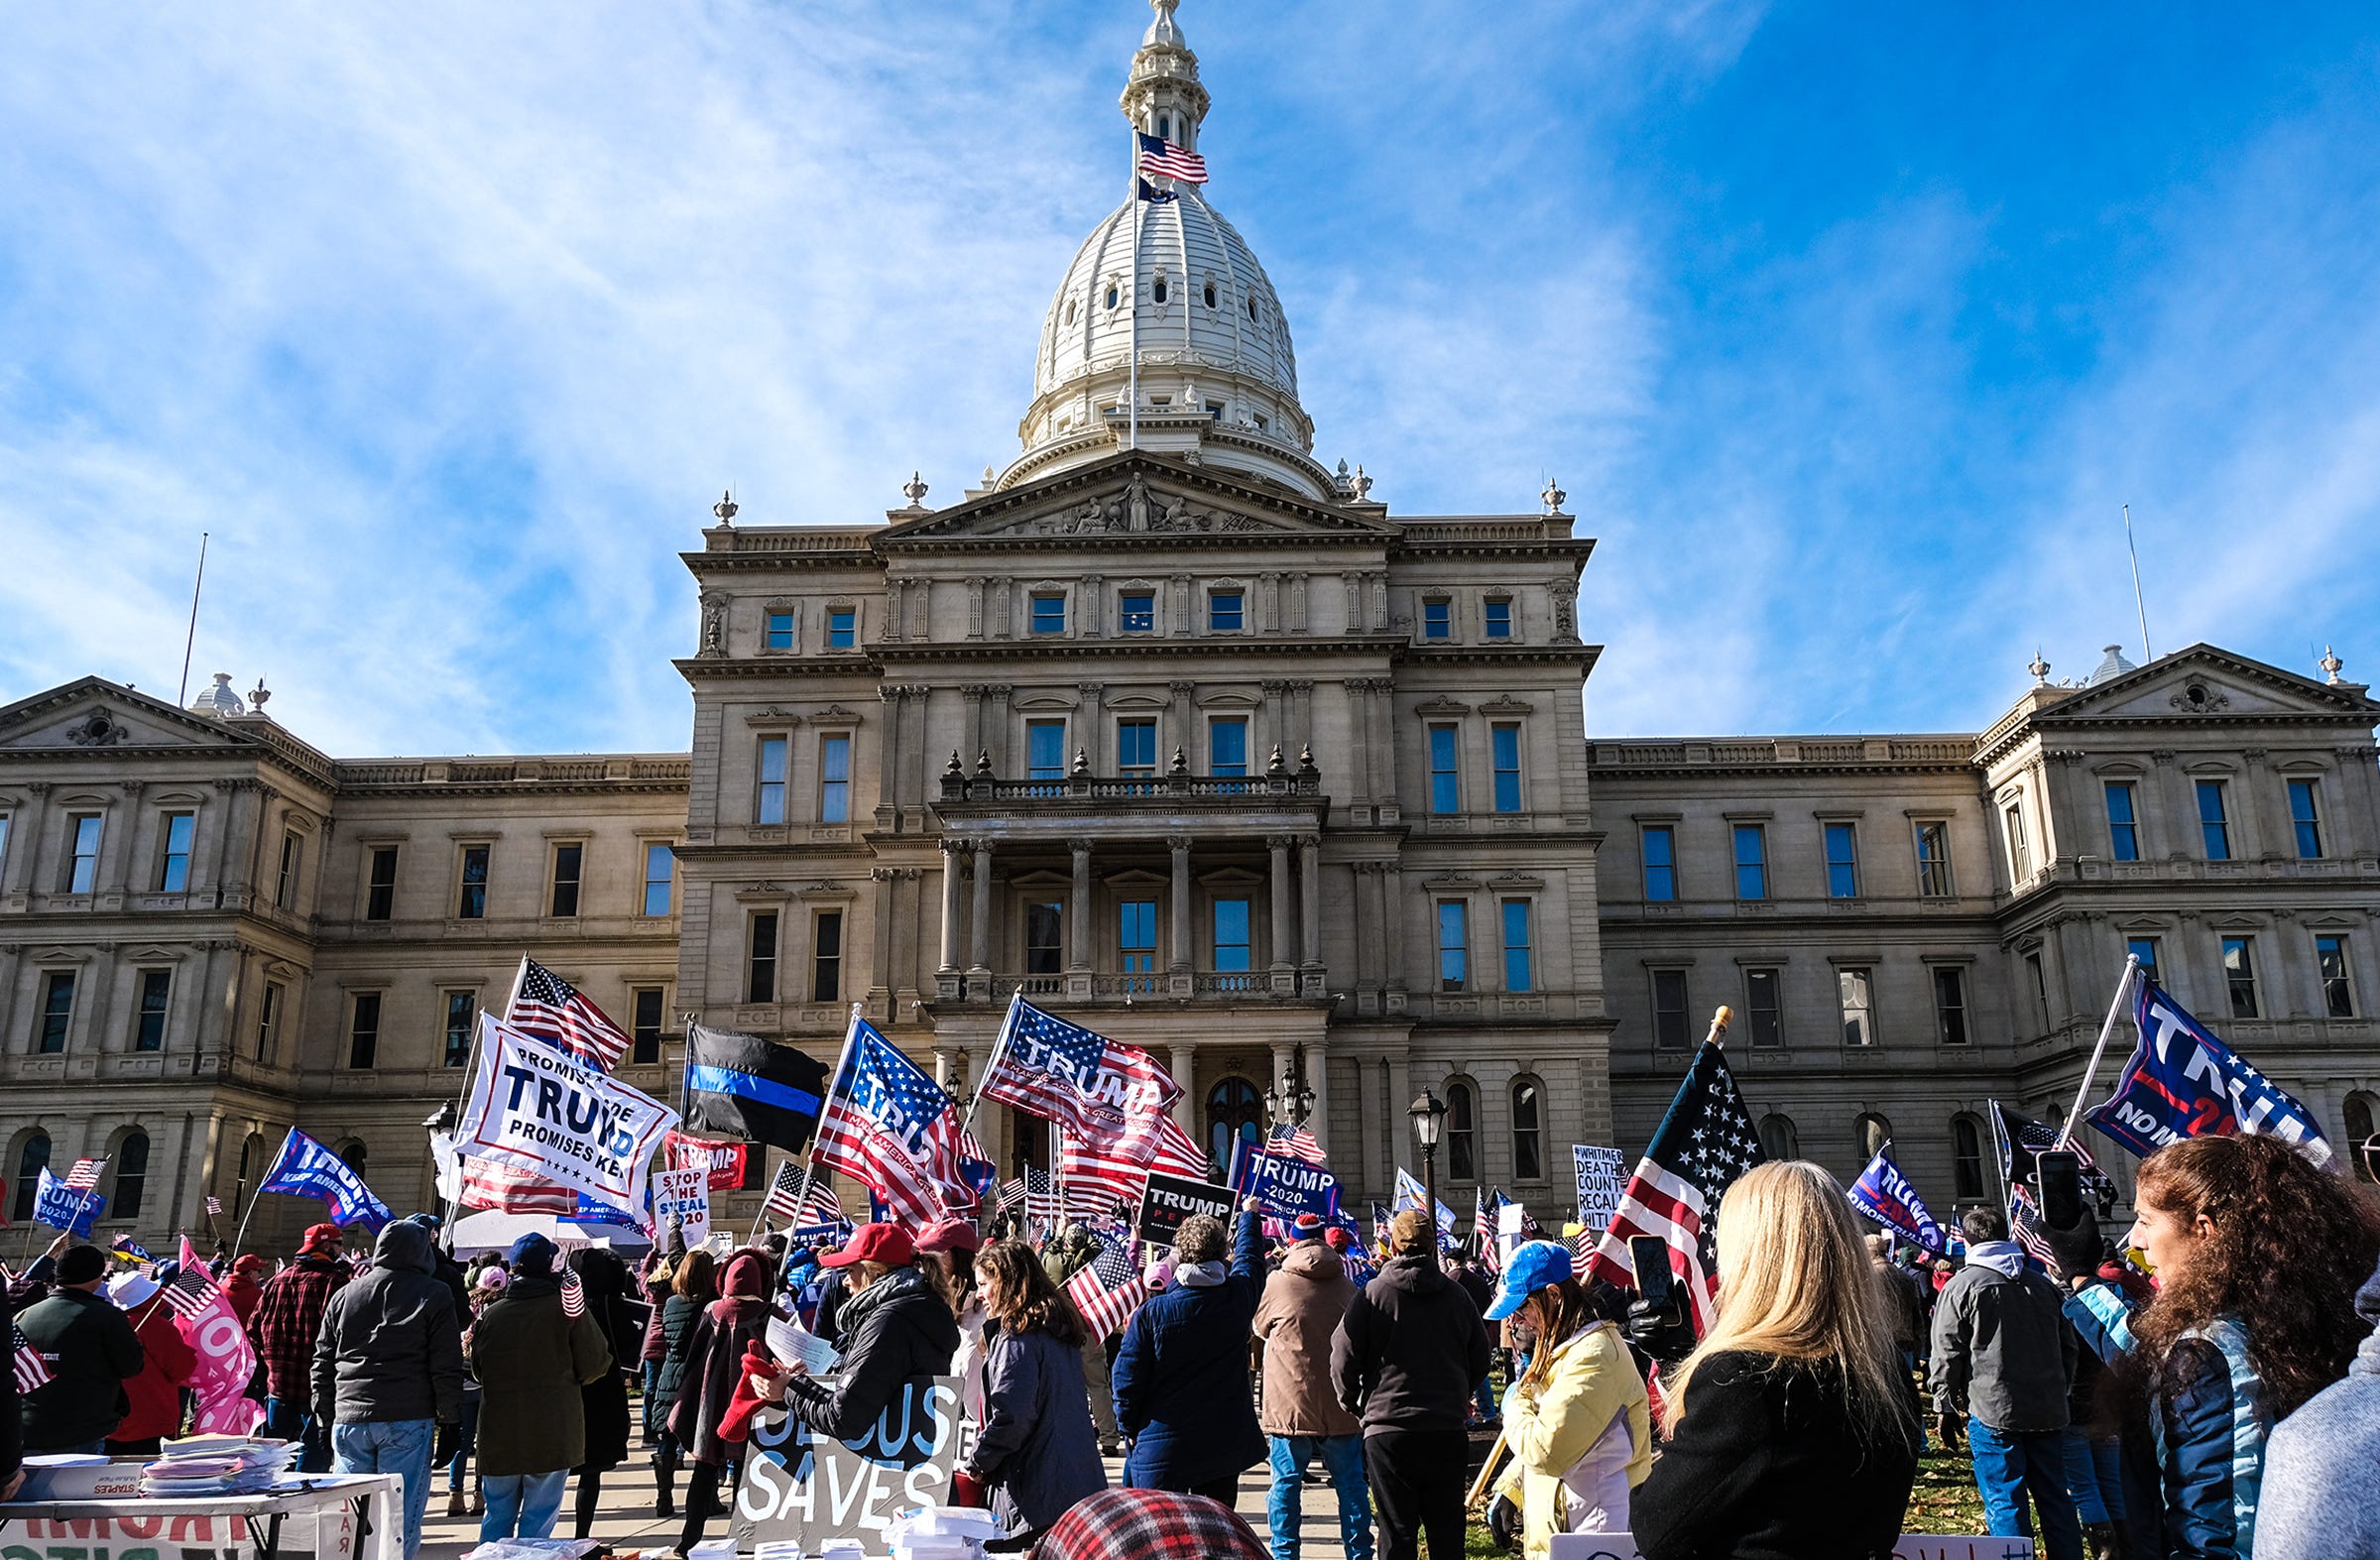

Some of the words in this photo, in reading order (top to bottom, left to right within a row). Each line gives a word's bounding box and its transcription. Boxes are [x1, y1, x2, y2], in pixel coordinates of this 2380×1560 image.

[518, 1047, 595, 1090] PROMIS
[1025, 1035, 1161, 1114] TRUMP
[1010, 1064, 1051, 1083] MAKING
[1092, 1109, 1125, 1125] GREAT
[2150, 1003, 2332, 1170] TRU
[867, 1071, 932, 1164] TRU
[2115, 1101, 2157, 1134] NO
[509, 1120, 594, 1162] PROMISES
[595, 1154, 625, 1179] KE
[875, 1137, 916, 1178] AMERICA
[662, 1172, 701, 1187] STOP
[1251, 1153, 1334, 1192] TRUMP
[1577, 1160, 1619, 1176] DEATH
[312, 1174, 356, 1216] AMERICA
[669, 1187, 698, 1200] THE
[1242, 1193, 1262, 1202] KP
[1264, 1185, 1308, 1204] -2020-
[1578, 1175, 1619, 1192] COUNT
[40, 1185, 91, 1213] RUMP
[659, 1198, 707, 1215] STEAL
[1150, 1188, 1230, 1217] TRUMP
[666, 1211, 704, 1225] 20
[793, 1231, 836, 1242] TRUP
[94, 1484, 135, 1494] STAPLES
[737, 1450, 944, 1530] SAVES
